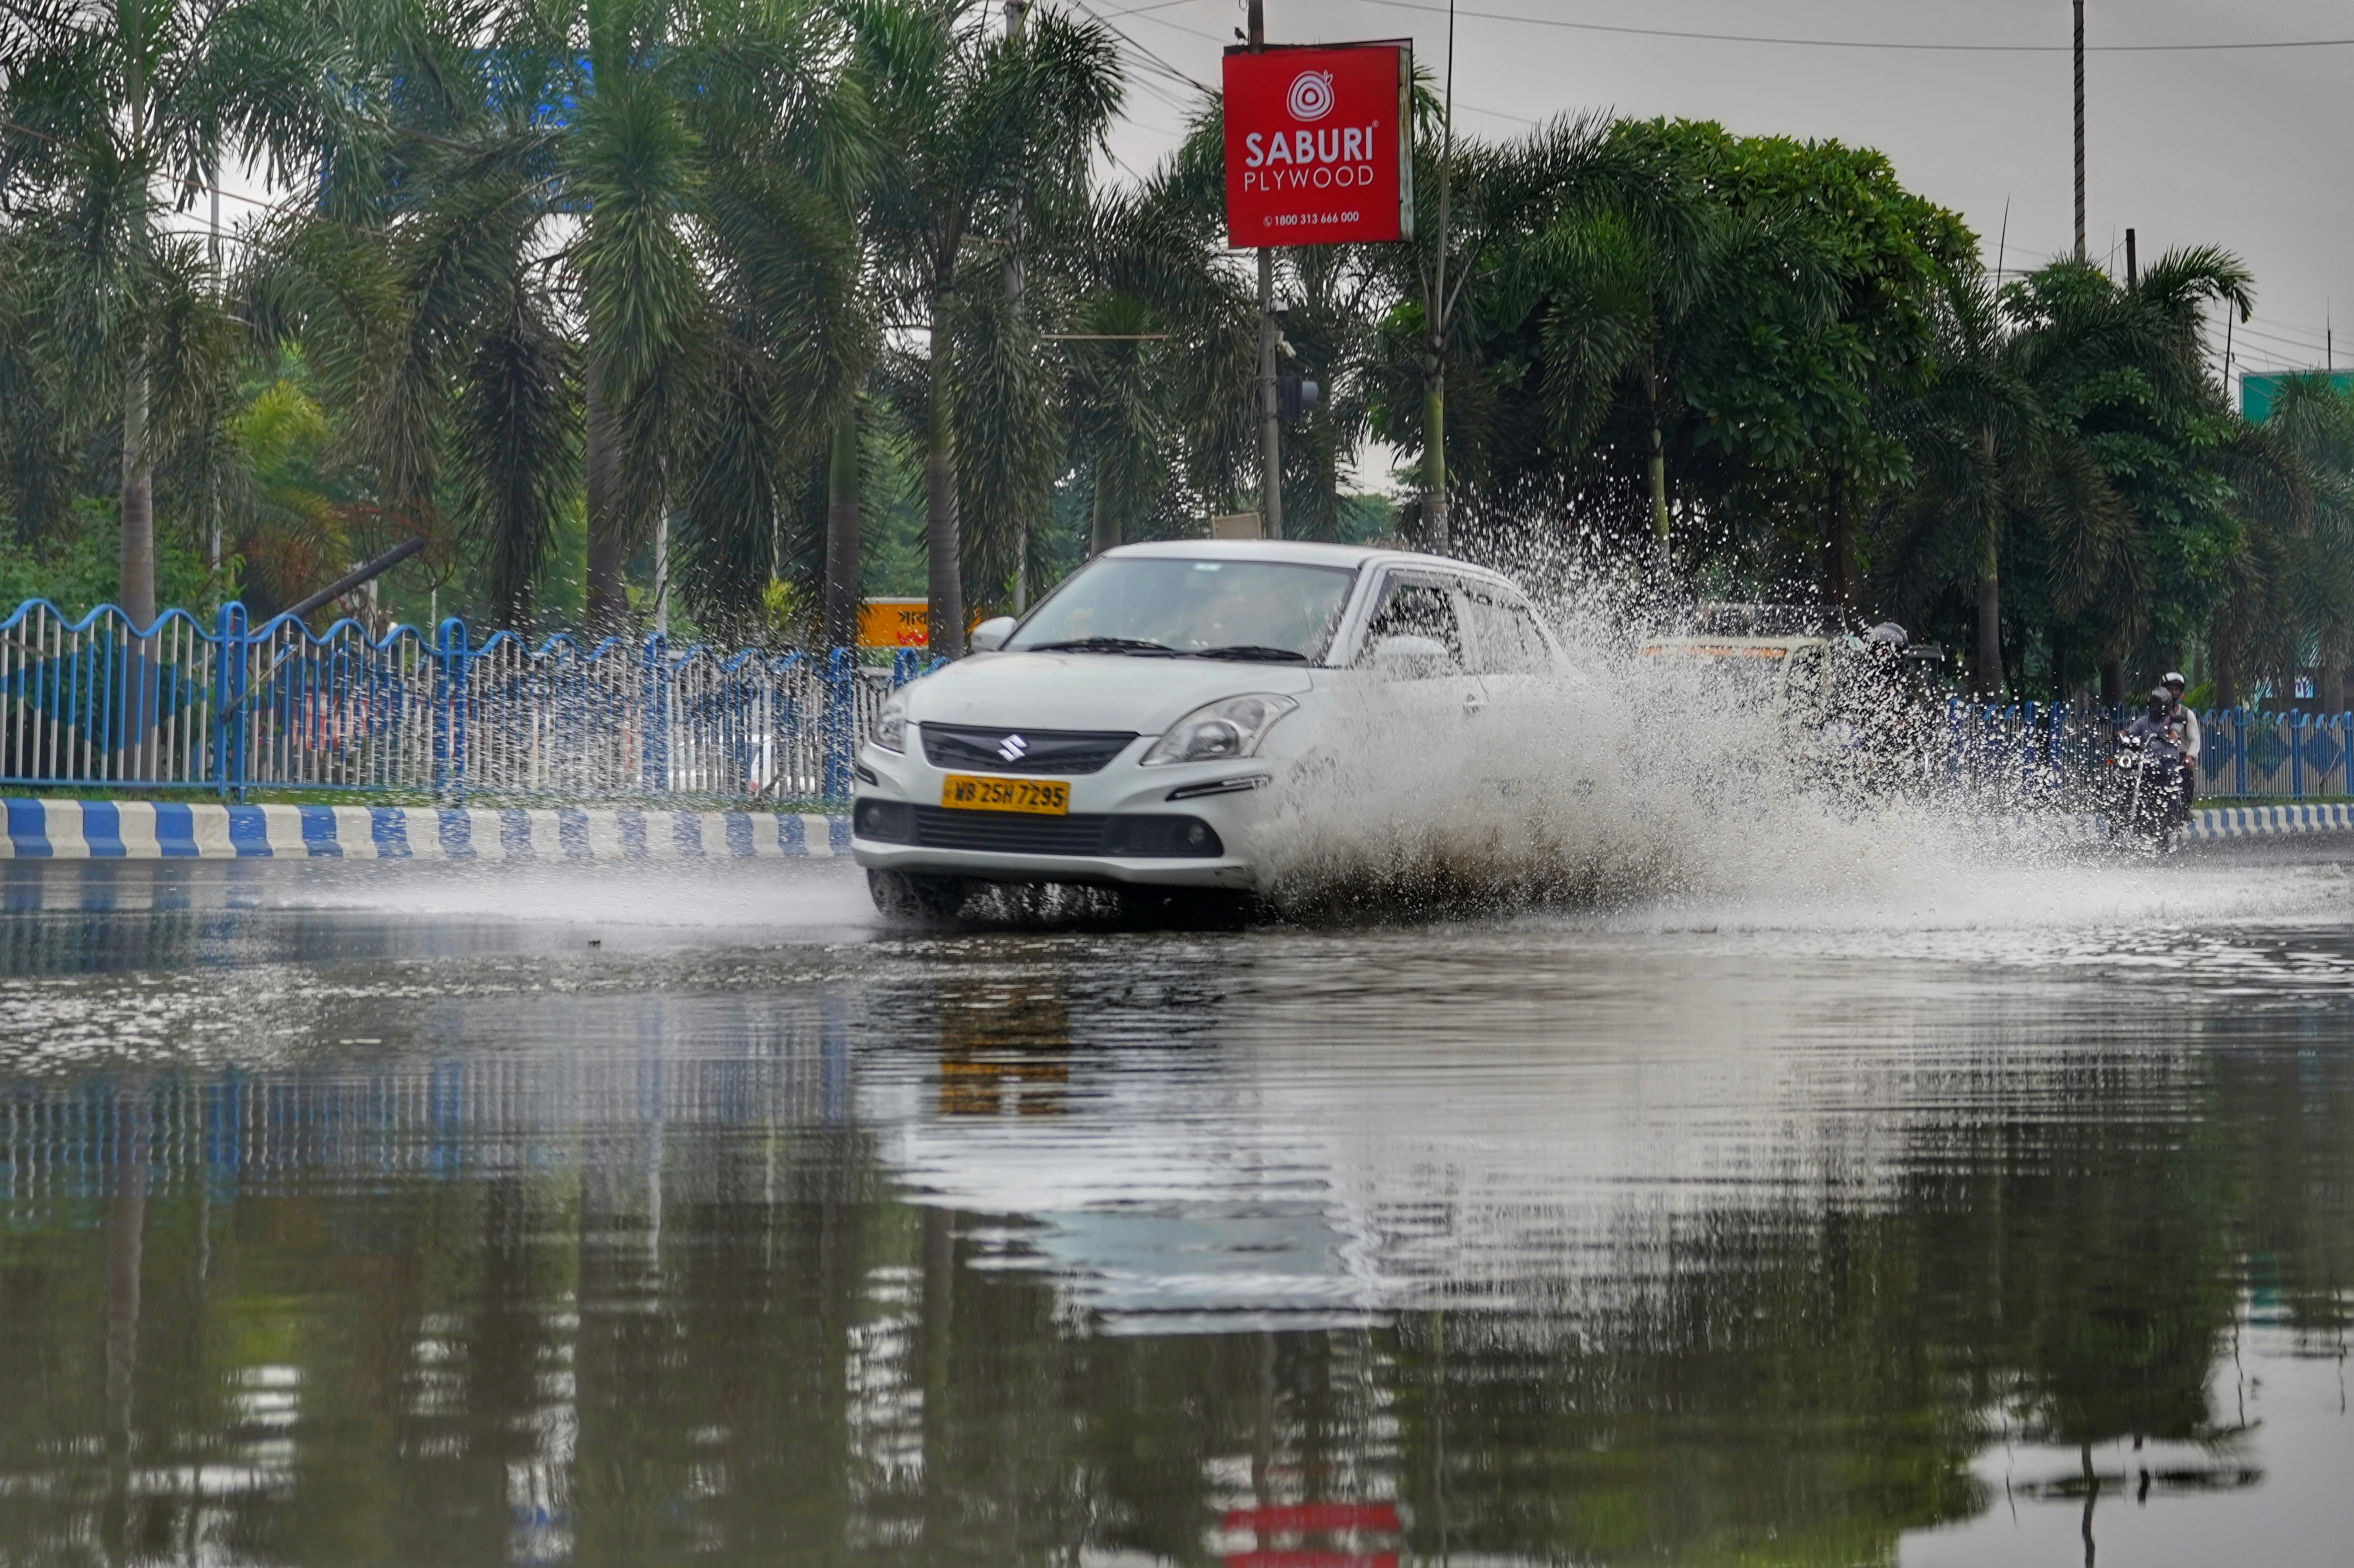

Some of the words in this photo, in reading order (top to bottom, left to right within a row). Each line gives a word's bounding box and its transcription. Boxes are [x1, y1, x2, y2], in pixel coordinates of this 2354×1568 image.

[1245, 126, 1373, 168] SABURI
[1245, 165, 1374, 192] PLYWOOD
[1274, 214, 1298, 226] 1800
[1300, 213, 1318, 225] 313
[1320, 212, 1338, 224] 666
[1340, 211, 1360, 223] 000
